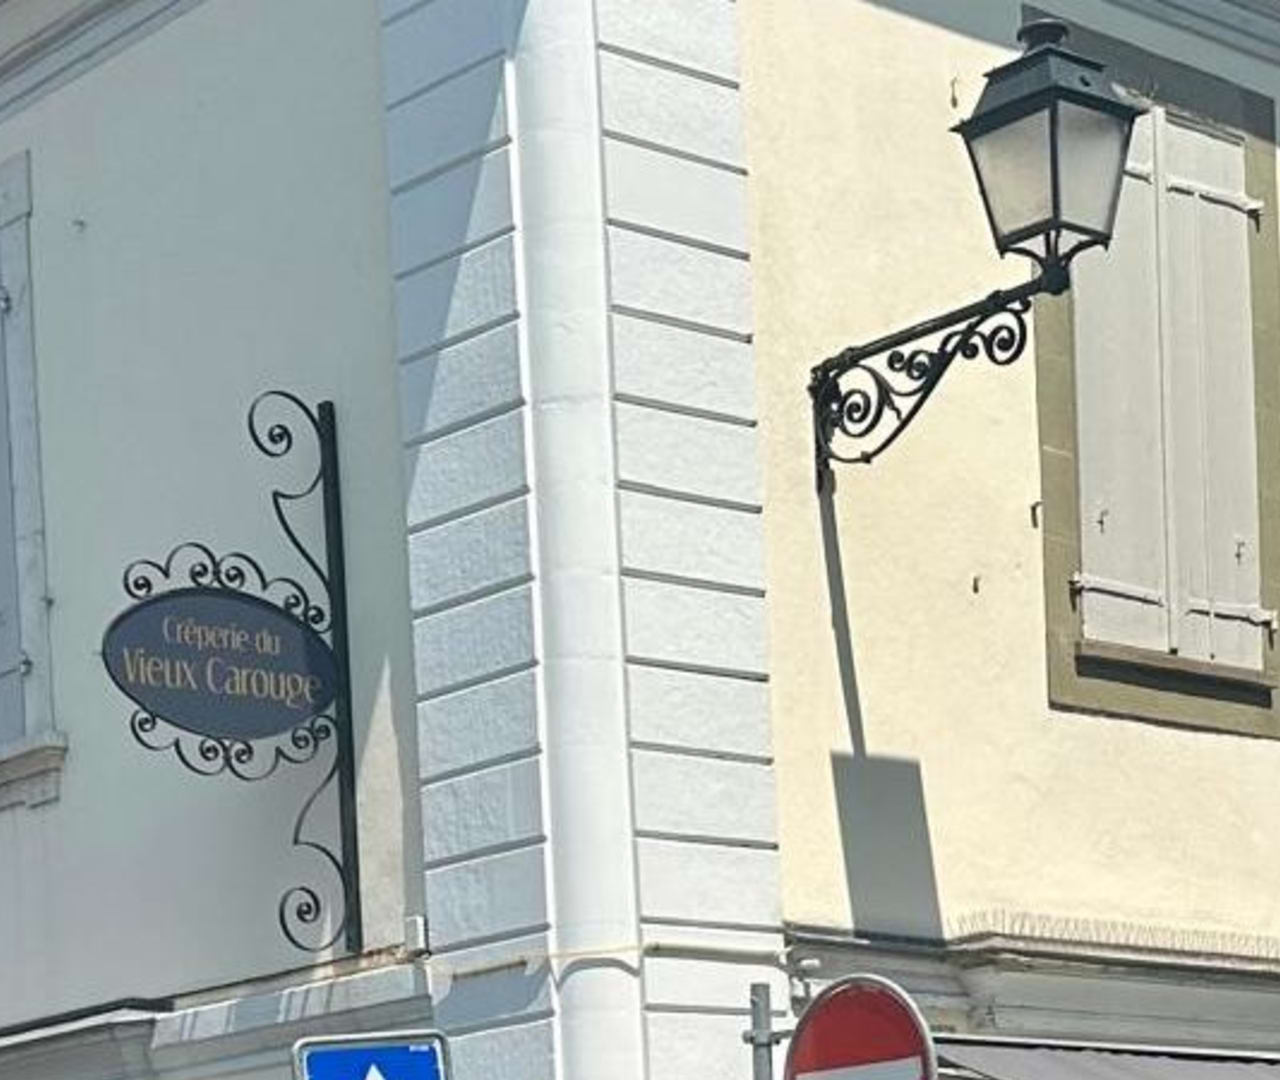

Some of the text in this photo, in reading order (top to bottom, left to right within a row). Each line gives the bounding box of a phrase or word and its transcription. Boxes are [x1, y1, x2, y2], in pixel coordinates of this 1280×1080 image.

[162, 614, 281, 654] Crêperie du
[122, 647, 322, 709] Vieux Carouge
